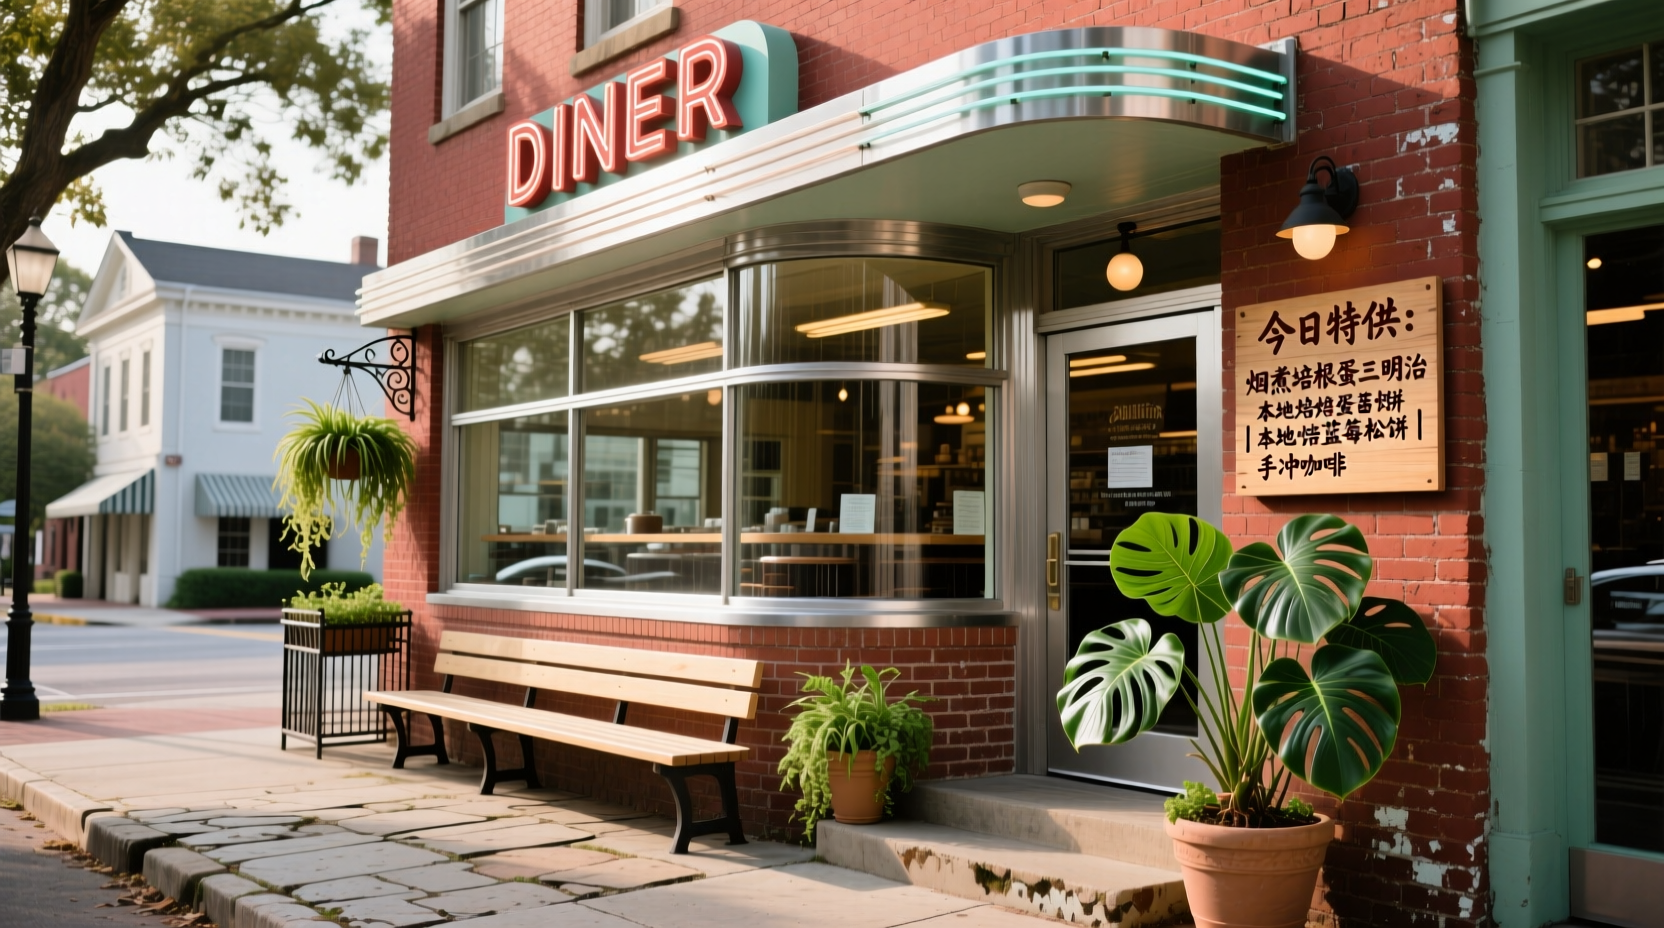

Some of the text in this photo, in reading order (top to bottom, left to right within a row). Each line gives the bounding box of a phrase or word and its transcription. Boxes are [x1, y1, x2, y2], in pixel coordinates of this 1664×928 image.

[506, 34, 743, 208] DINER
[1258, 452, 1347, 481] 手冲咖啡
